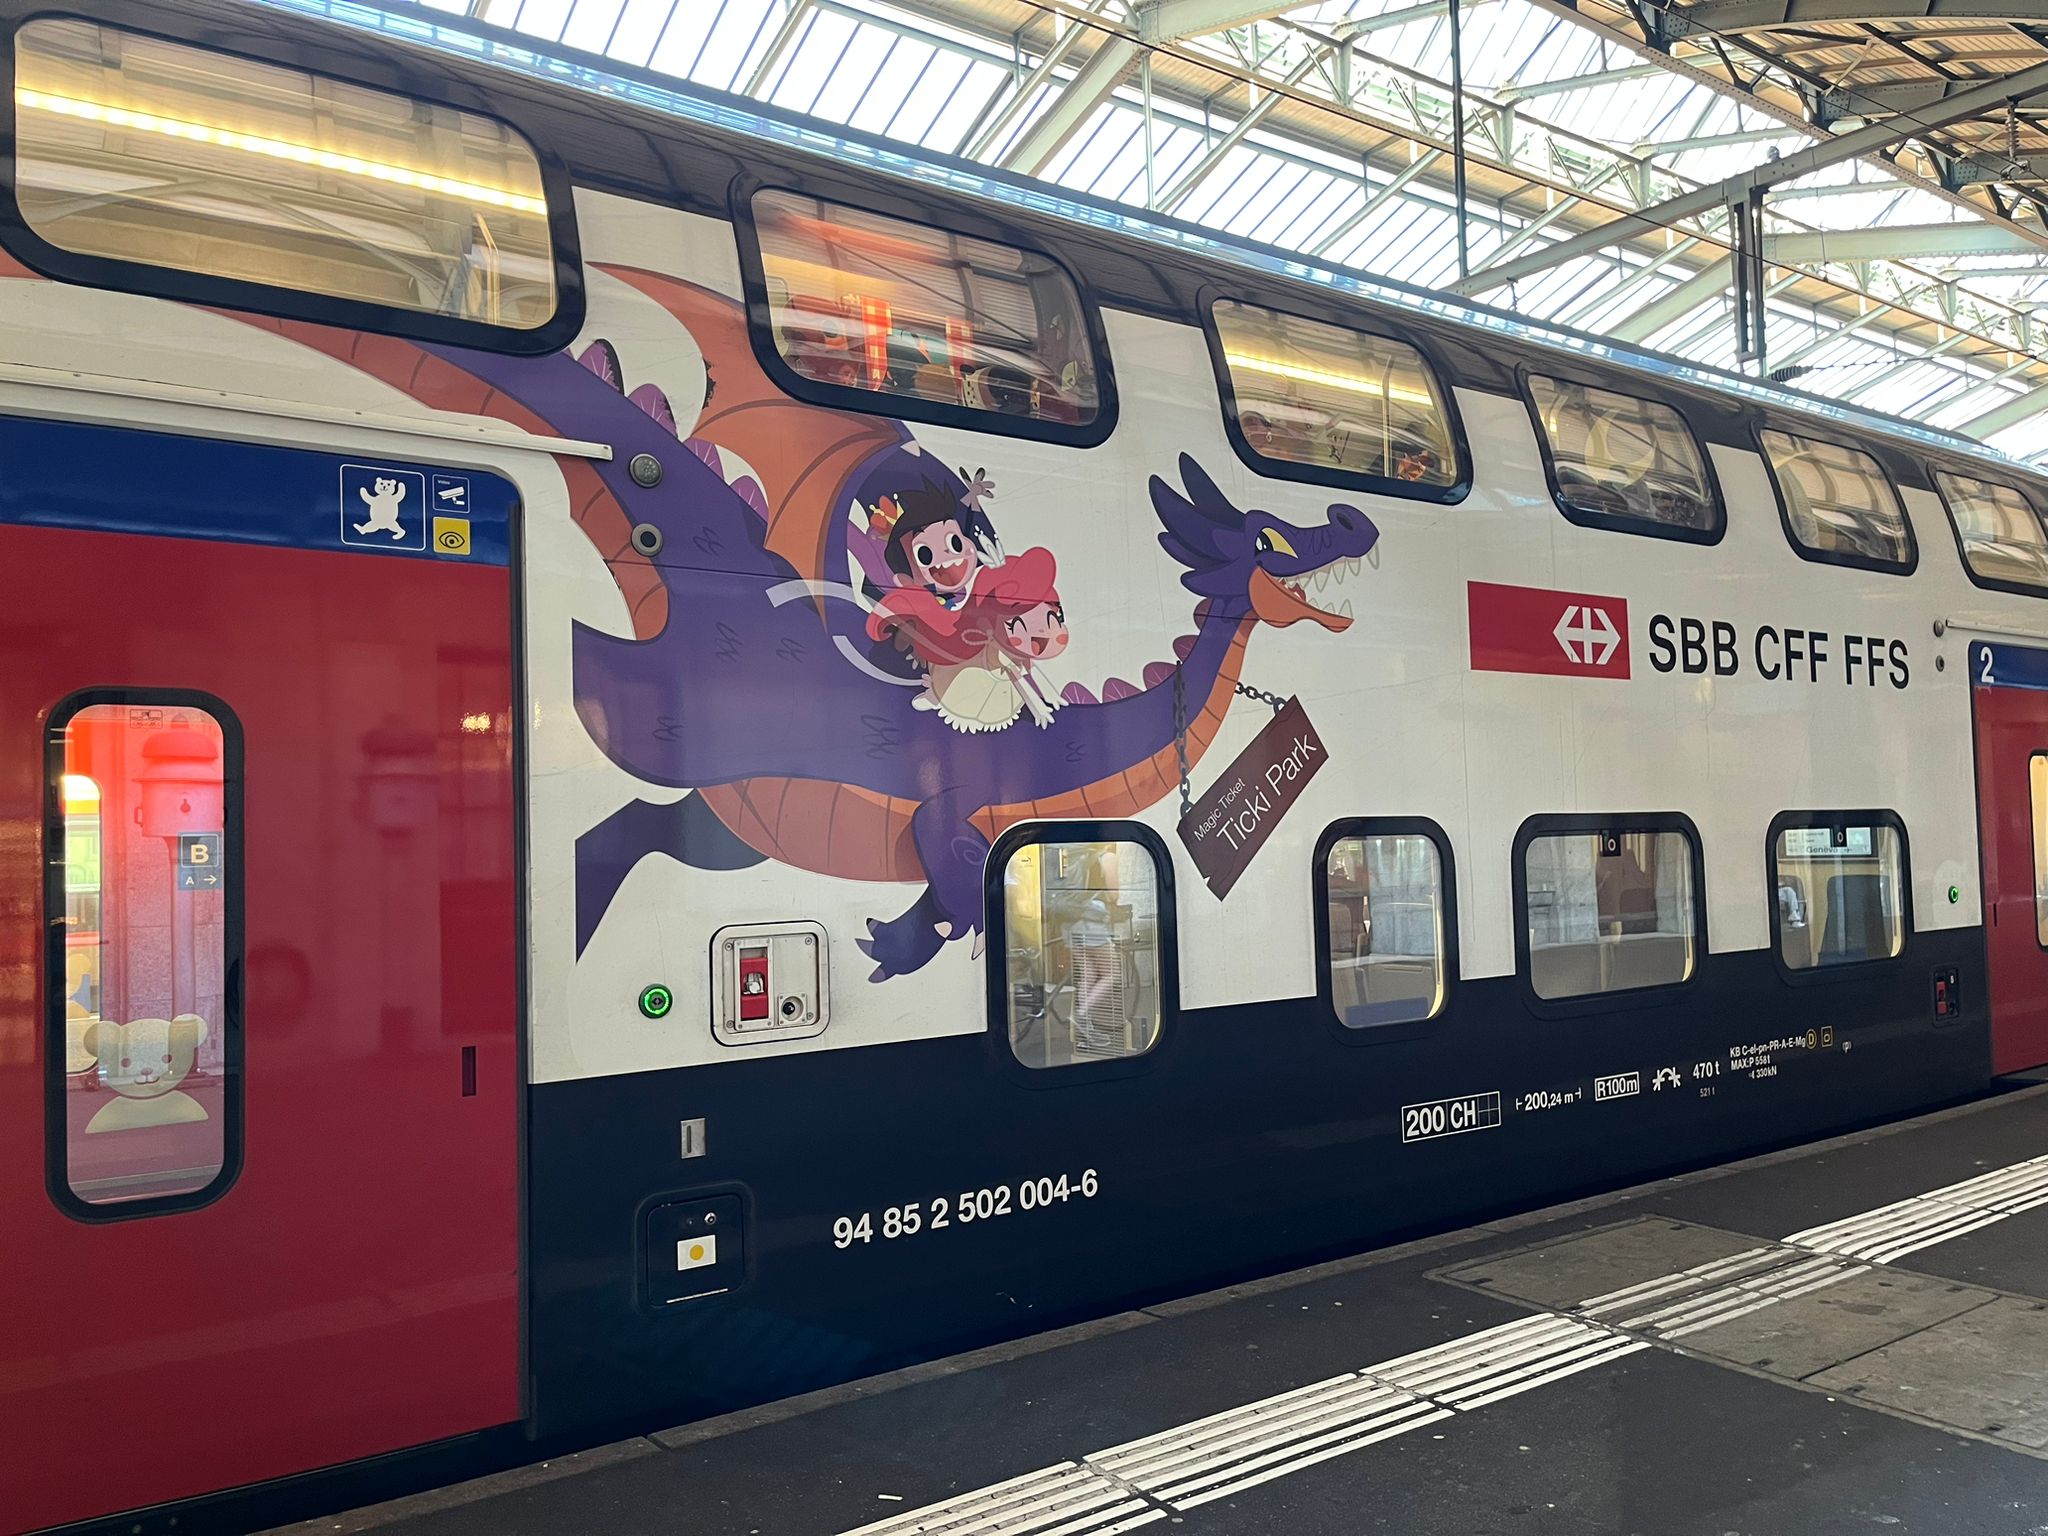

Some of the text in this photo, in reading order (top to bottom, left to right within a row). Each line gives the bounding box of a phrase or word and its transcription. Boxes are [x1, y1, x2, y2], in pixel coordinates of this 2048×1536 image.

[1648, 613, 1911, 690] SBB CFF FFS
[1979, 645, 1995, 684] 2
[1216, 734, 1318, 851] Ticki Park
[1193, 777, 1247, 842] Magic Ticket
[191, 843, 210, 864] B
[185, 875, 195, 886] A
[1730, 1046, 1741, 1058] KB
[1692, 1060, 1720, 1080] 470 t
[1524, 1091, 1562, 1111] 200,24
[1597, 1077, 1638, 1098] R100m
[1406, 1099, 1477, 1137] 200 CH
[833, 1168, 1099, 1249] 94 85 2 502 004-6
